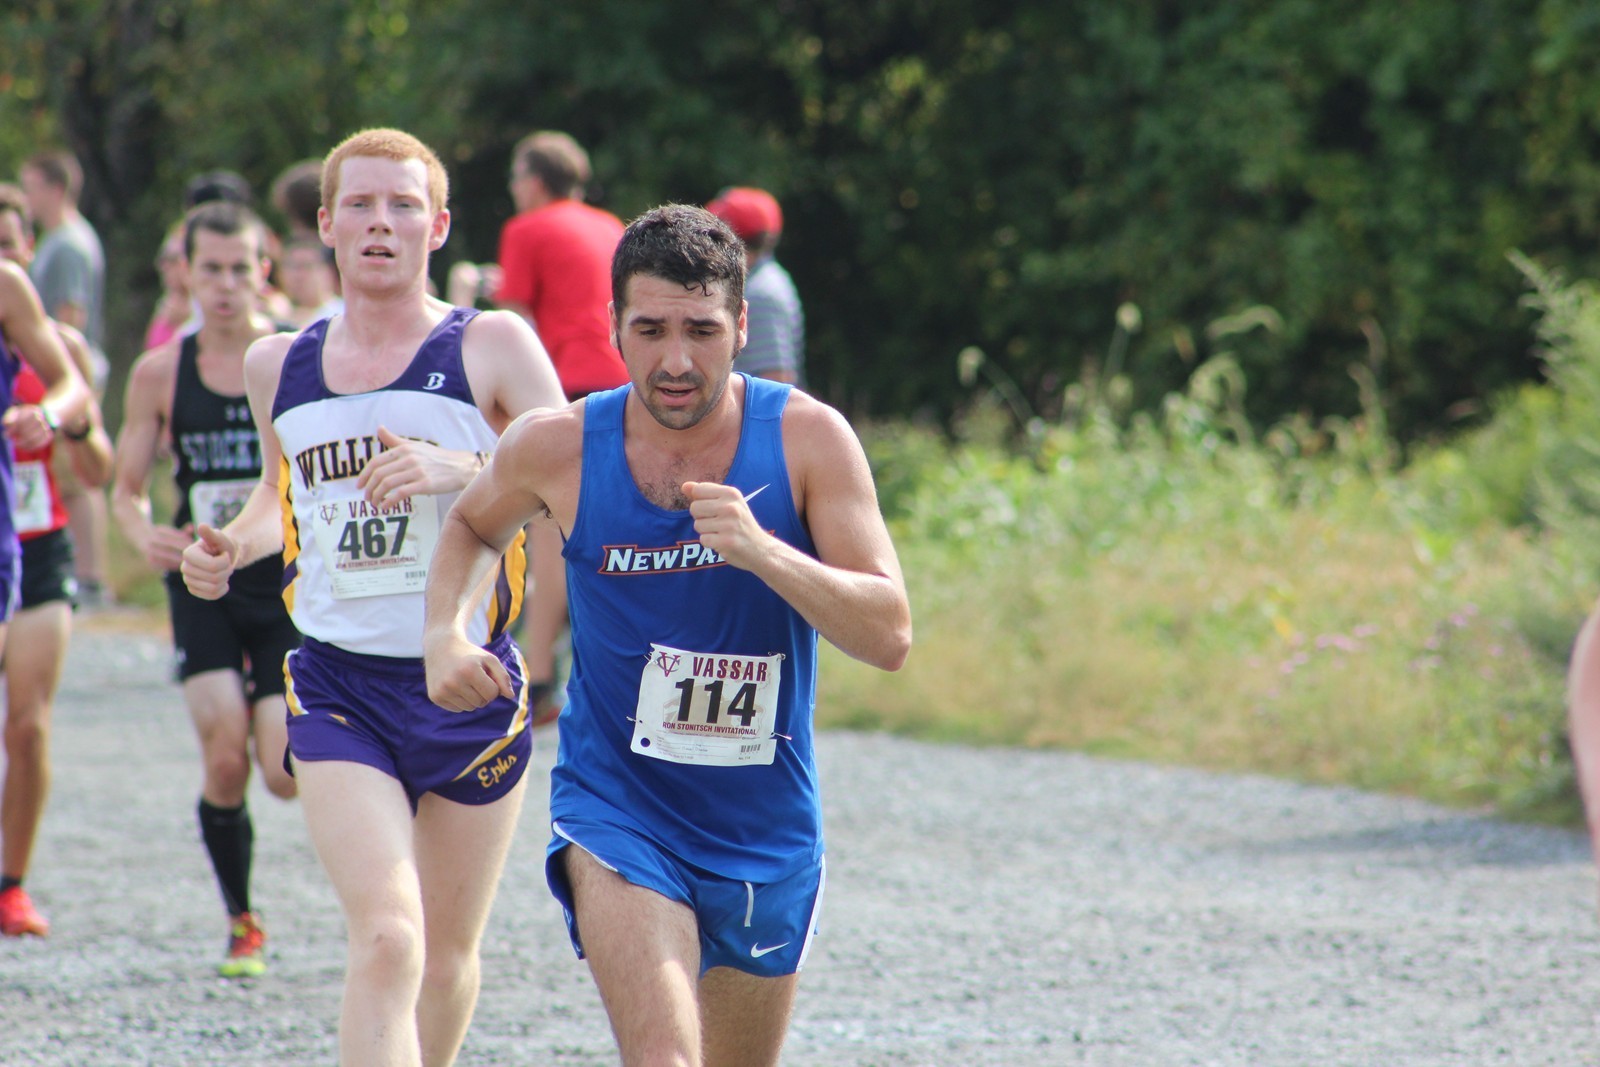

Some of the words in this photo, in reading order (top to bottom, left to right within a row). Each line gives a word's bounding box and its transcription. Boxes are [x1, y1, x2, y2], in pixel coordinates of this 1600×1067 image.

[337, 515, 409, 560] 467
[692, 656, 768, 682] VASSAR
[675, 677, 758, 727] 114
[662, 721, 676, 730] RON
[677, 722, 713, 733] STONITSCH
[713, 725, 758, 736] INVITATIONAL
[477, 754, 518, 788] Ephs
